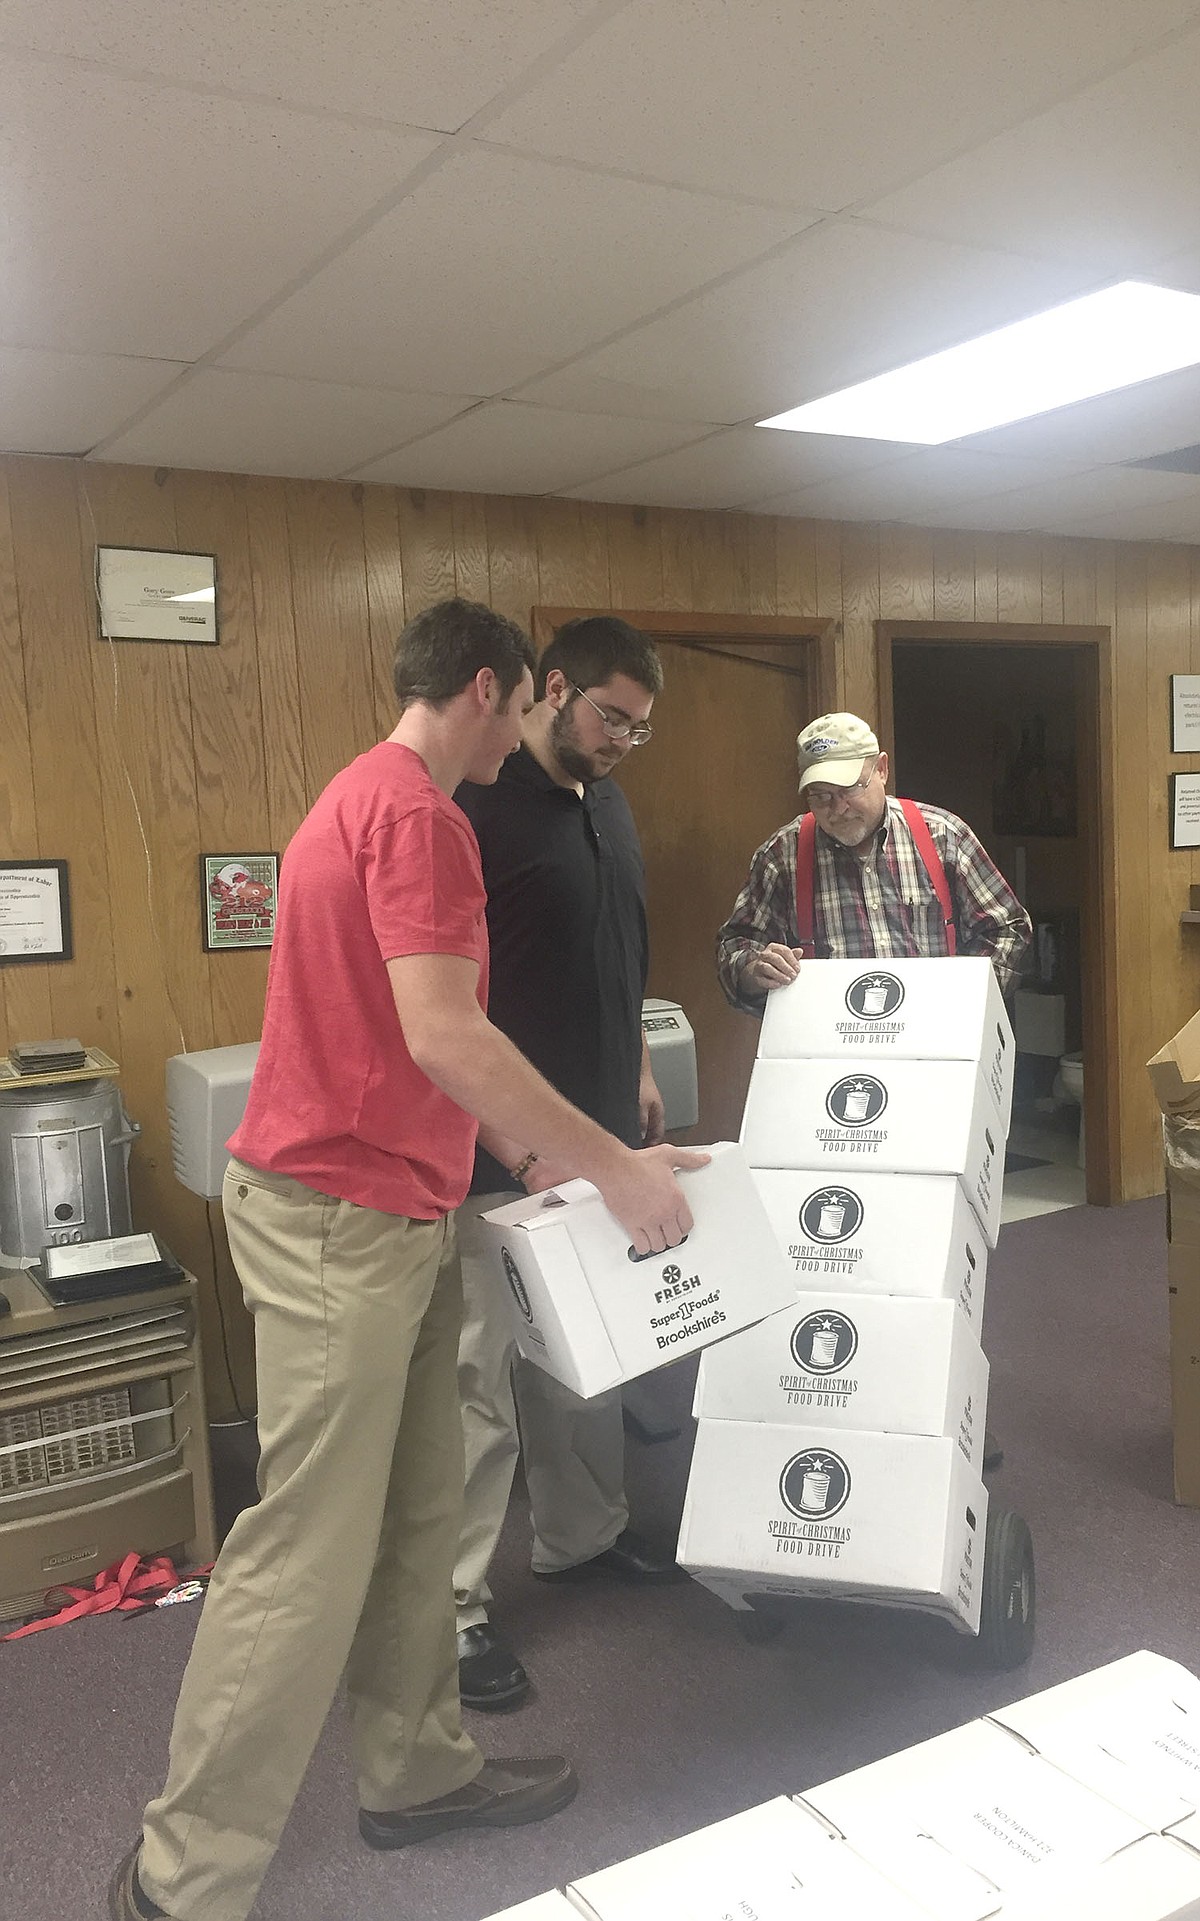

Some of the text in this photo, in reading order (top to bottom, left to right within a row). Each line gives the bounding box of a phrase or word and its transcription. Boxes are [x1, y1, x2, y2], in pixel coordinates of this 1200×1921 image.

[835, 1022, 860, 1031] SPIRIT
[864, 1022, 905, 1031] CHRISTMAS
[842, 1034, 897, 1043] FOOD DRIVE
[815, 1129, 841, 1139] SPIRIT
[845, 1129, 888, 1140] CHRISTMAS
[822, 1142, 879, 1153] FOOD DRIVE
[788, 1245, 815, 1257] SPIRIT
[819, 1246, 863, 1260] CHRISTMAS
[795, 1260, 854, 1274] FOOD DRIVE
[654, 1275, 701, 1303] FRESH
[656, 1310, 727, 1349] Brookshire's
[779, 1375, 807, 1388] SPIRIT
[812, 1378, 858, 1392] CHRISTMAS
[787, 1392, 848, 1408] FOOD DRIVE
[768, 1520, 797, 1536] SPIRIT
[802, 1523, 851, 1542] CHRISTMAS
[776, 1539, 841, 1559] FOOD DRIVE
[973, 1812, 1009, 1841] COOPER
